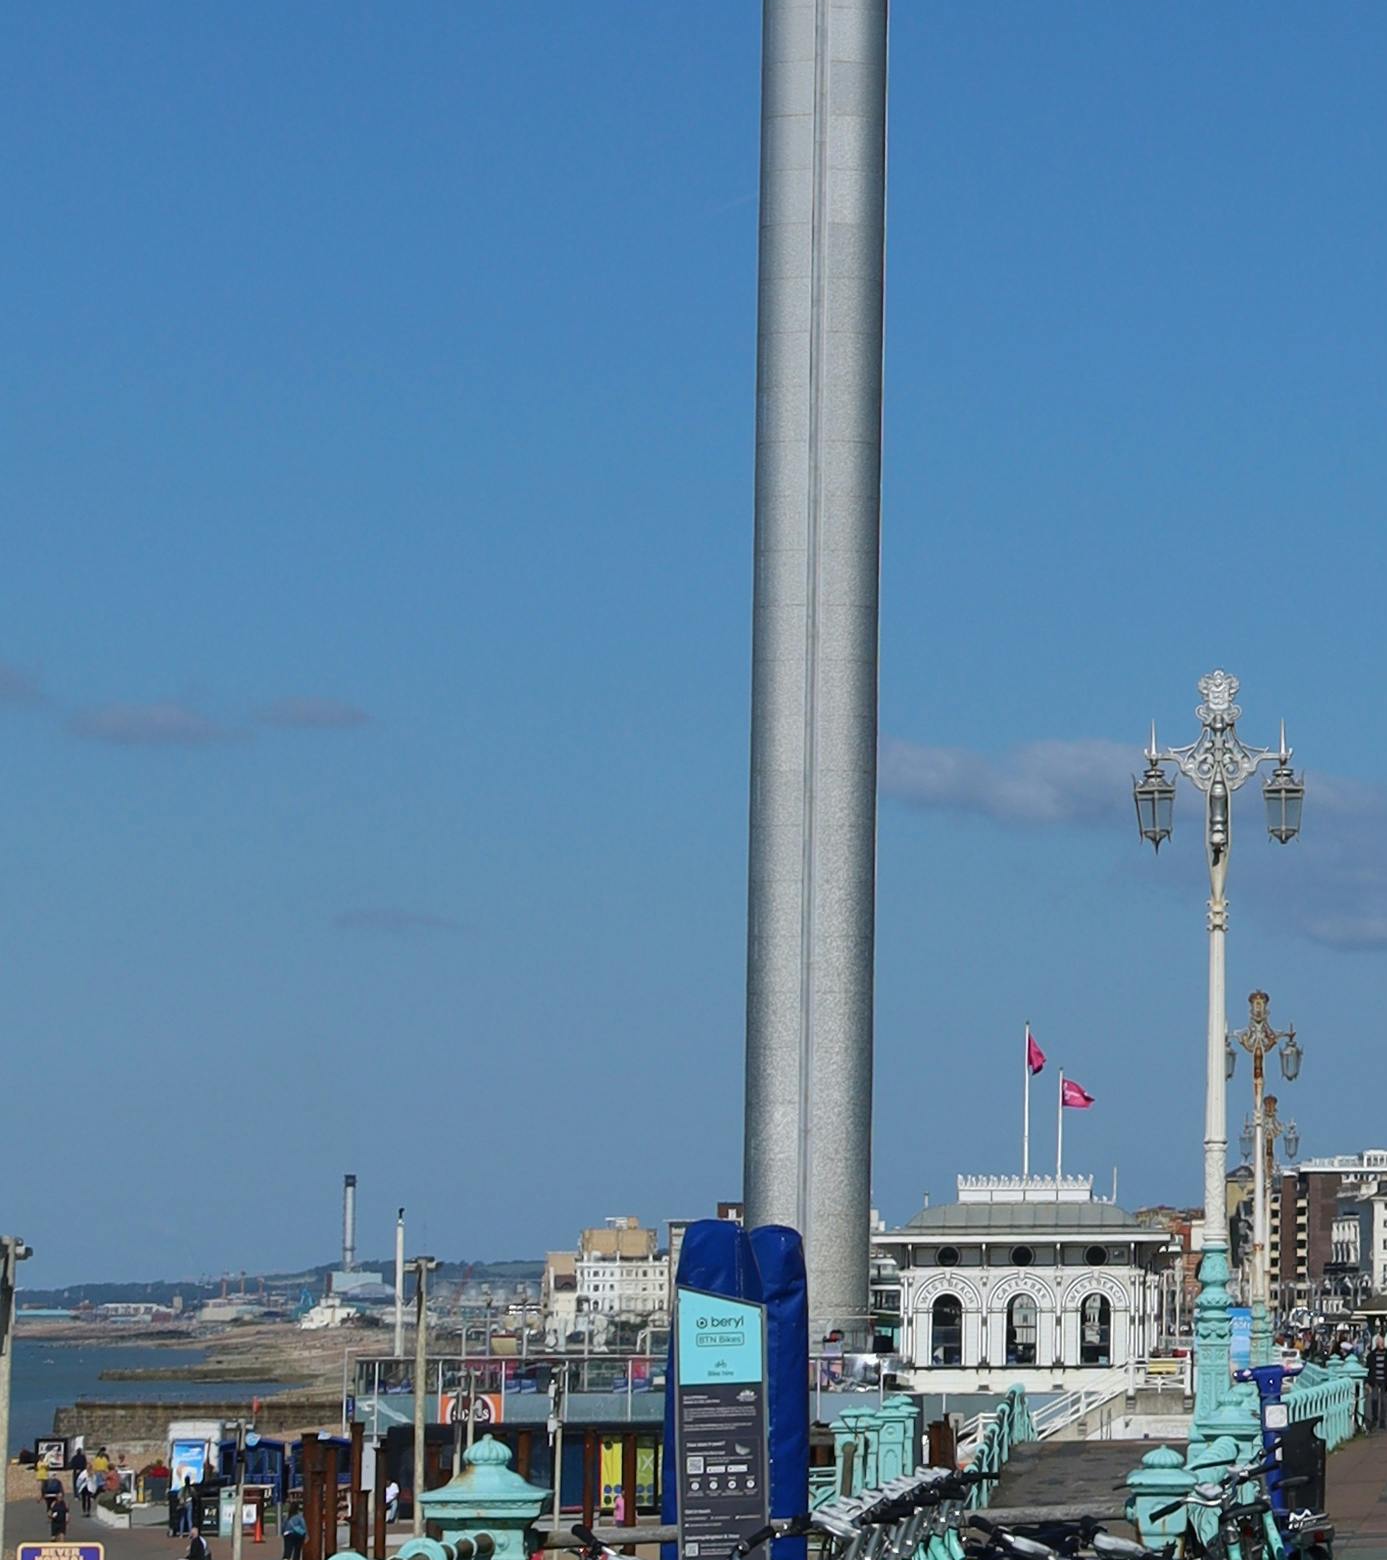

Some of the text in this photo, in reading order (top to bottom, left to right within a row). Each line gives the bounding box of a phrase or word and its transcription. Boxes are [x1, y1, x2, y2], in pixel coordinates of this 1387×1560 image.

[919, 1280, 975, 1306] WEST BEACH
[1067, 1280, 1124, 1305] WEST BEACH
[711, 1316, 744, 1328] beryl
[41, 1548, 80, 1556] NEVER
